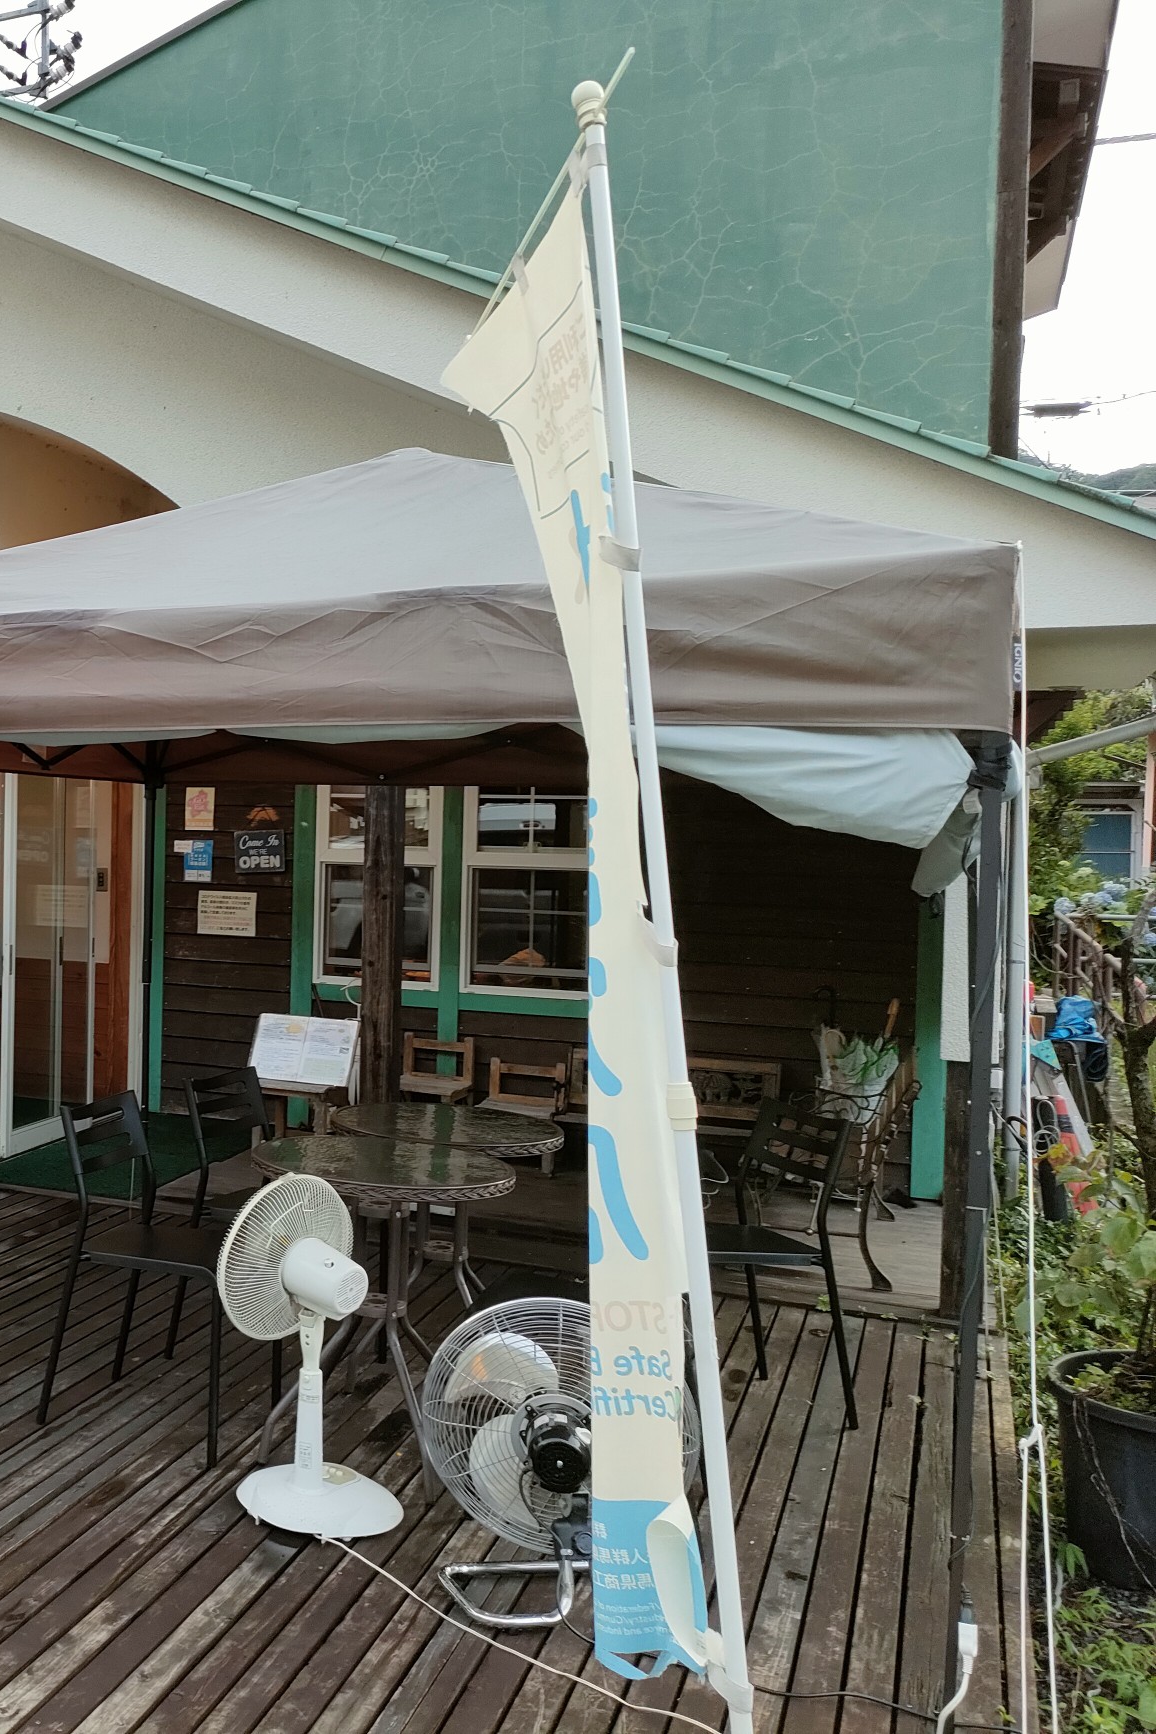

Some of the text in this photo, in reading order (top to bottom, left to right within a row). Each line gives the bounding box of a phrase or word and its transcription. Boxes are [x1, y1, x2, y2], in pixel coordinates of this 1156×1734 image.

[239, 834, 280, 850] Come In
[239, 854, 281, 869] OPEN
